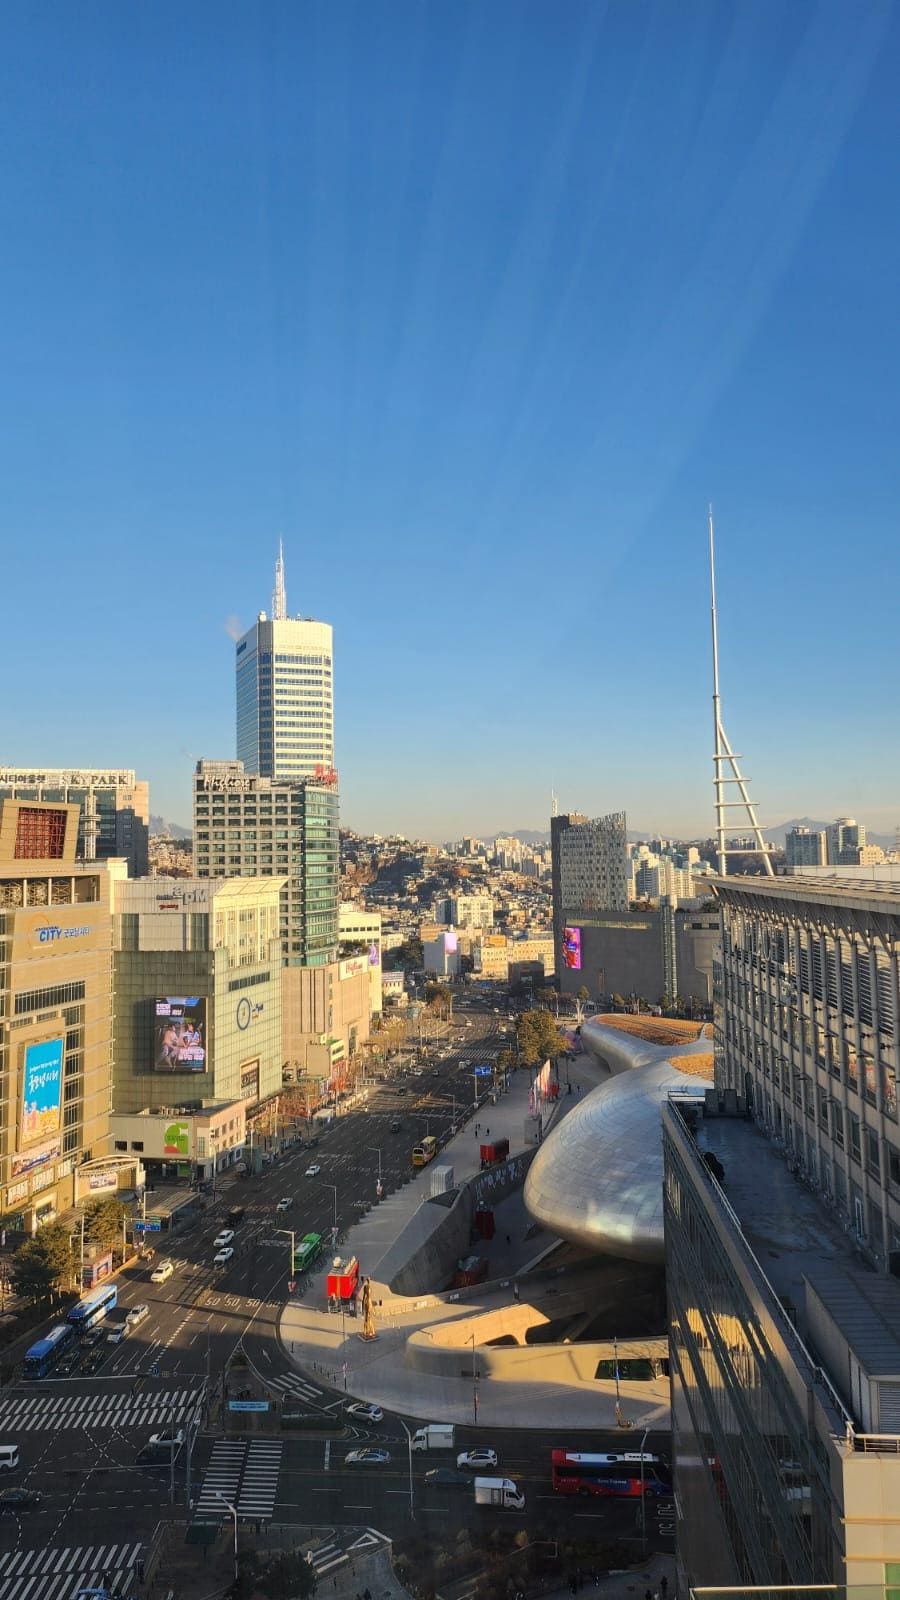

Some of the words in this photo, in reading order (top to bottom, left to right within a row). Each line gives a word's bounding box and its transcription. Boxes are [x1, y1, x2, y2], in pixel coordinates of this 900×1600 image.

[91, 775, 129, 785] PARK
[204, 773, 250, 792] Migliore
[39, 928, 62, 942] CITY
[204, 1297, 221, 1306] 50
[224, 1298, 241, 1307] 50
[245, 1298, 261, 1307] 50
